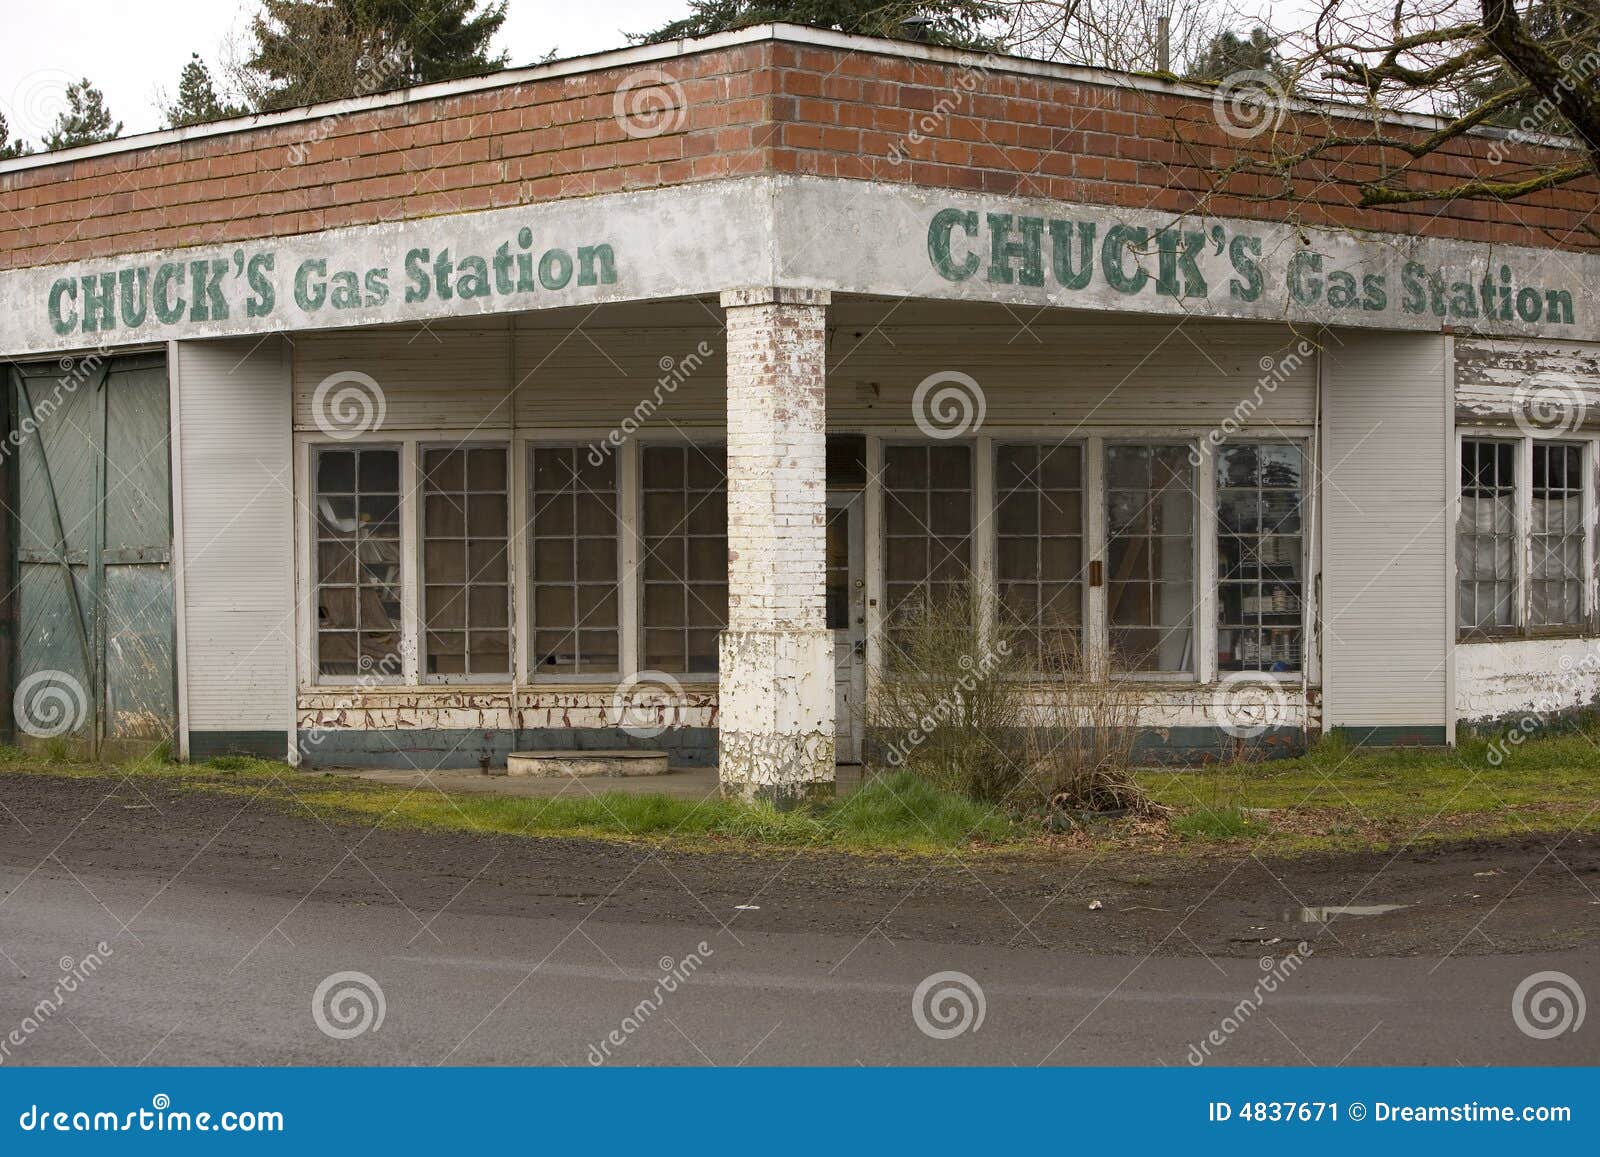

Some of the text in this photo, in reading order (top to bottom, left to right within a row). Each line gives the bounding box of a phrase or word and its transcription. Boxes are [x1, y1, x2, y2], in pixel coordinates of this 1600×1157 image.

[48, 226, 618, 336] CHUCK'S Gas Station
[927, 207, 1576, 325] CHUCK'S Gas Station
